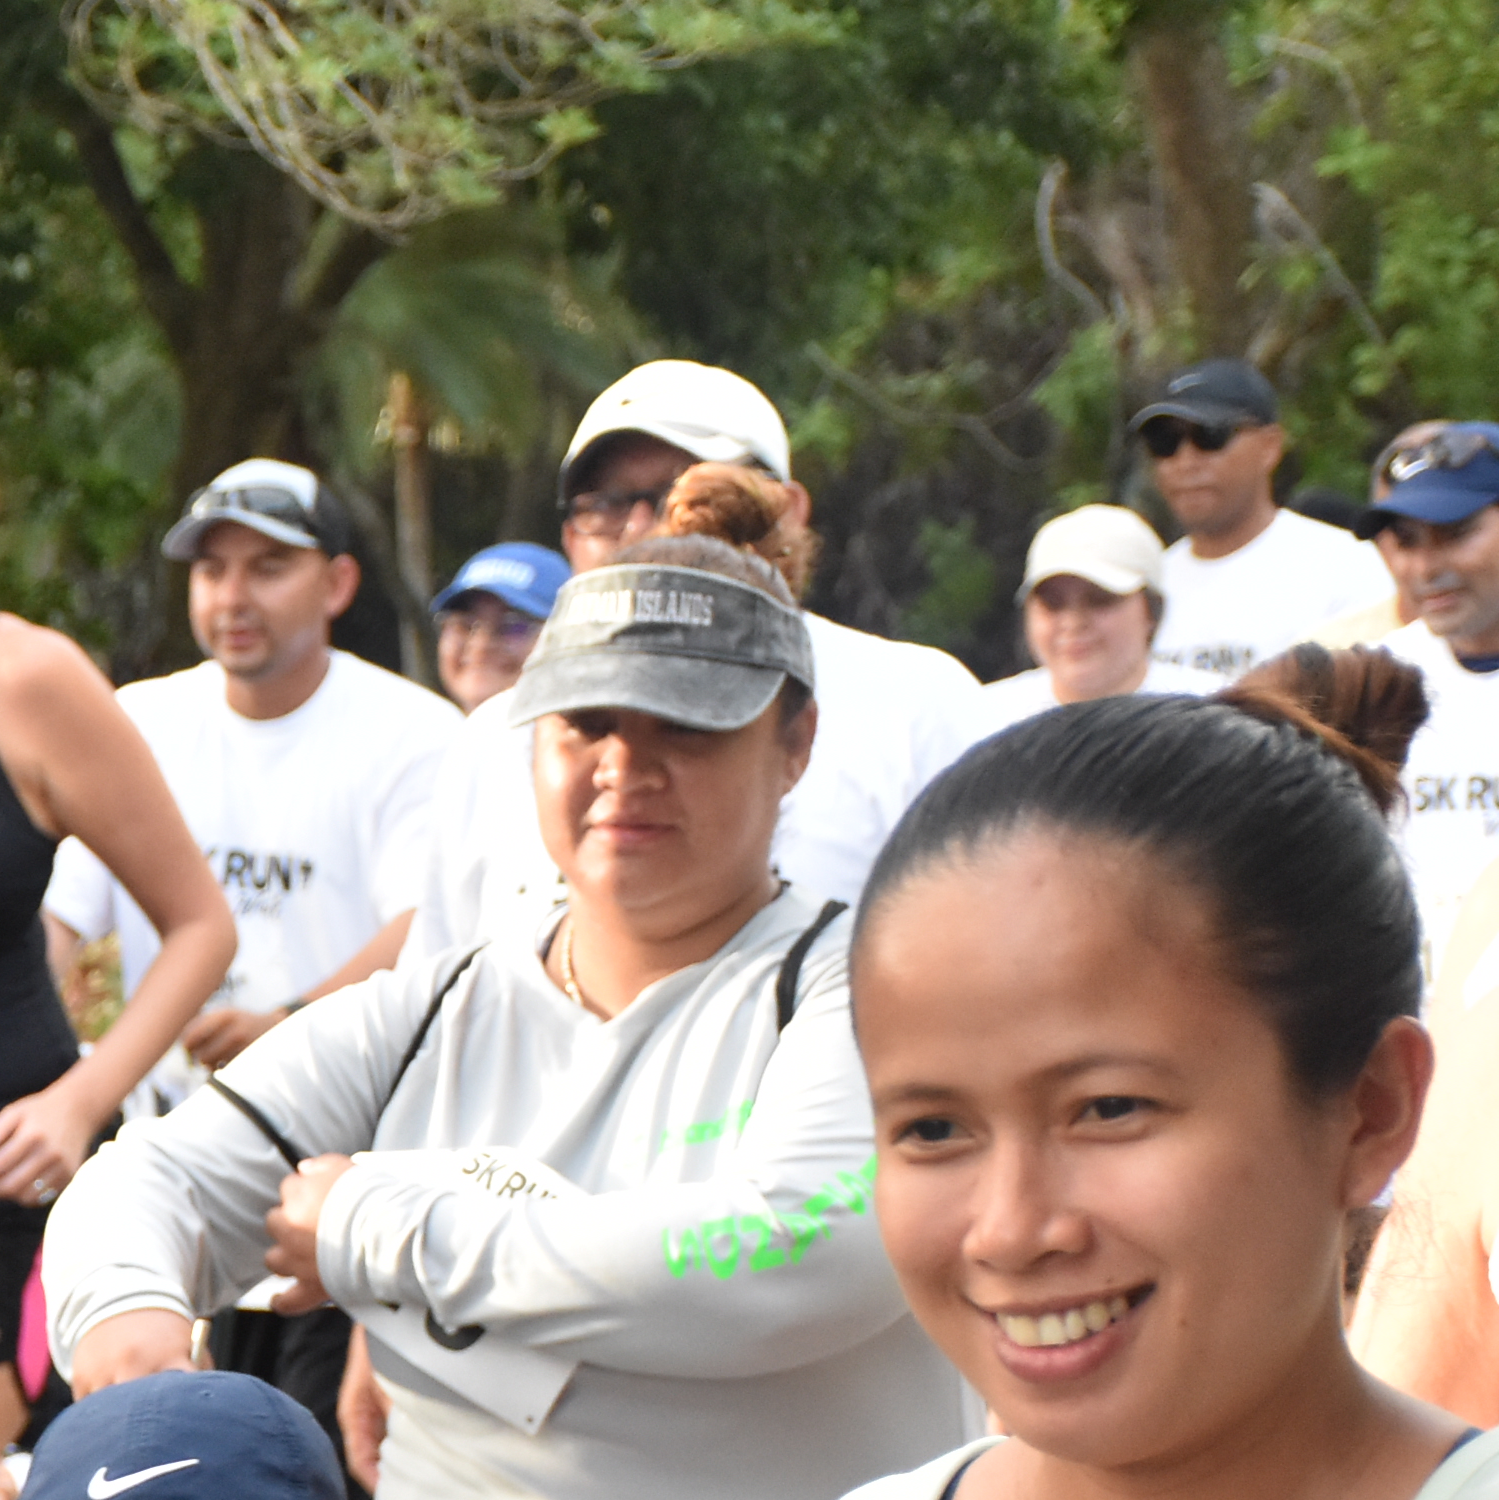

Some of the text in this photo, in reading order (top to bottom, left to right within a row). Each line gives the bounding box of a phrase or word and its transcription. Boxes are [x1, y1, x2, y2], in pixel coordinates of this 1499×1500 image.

[635, 590, 714, 627] ISLANDS
[1414, 775, 1458, 812] 5K
[223, 851, 291, 892] RUN
